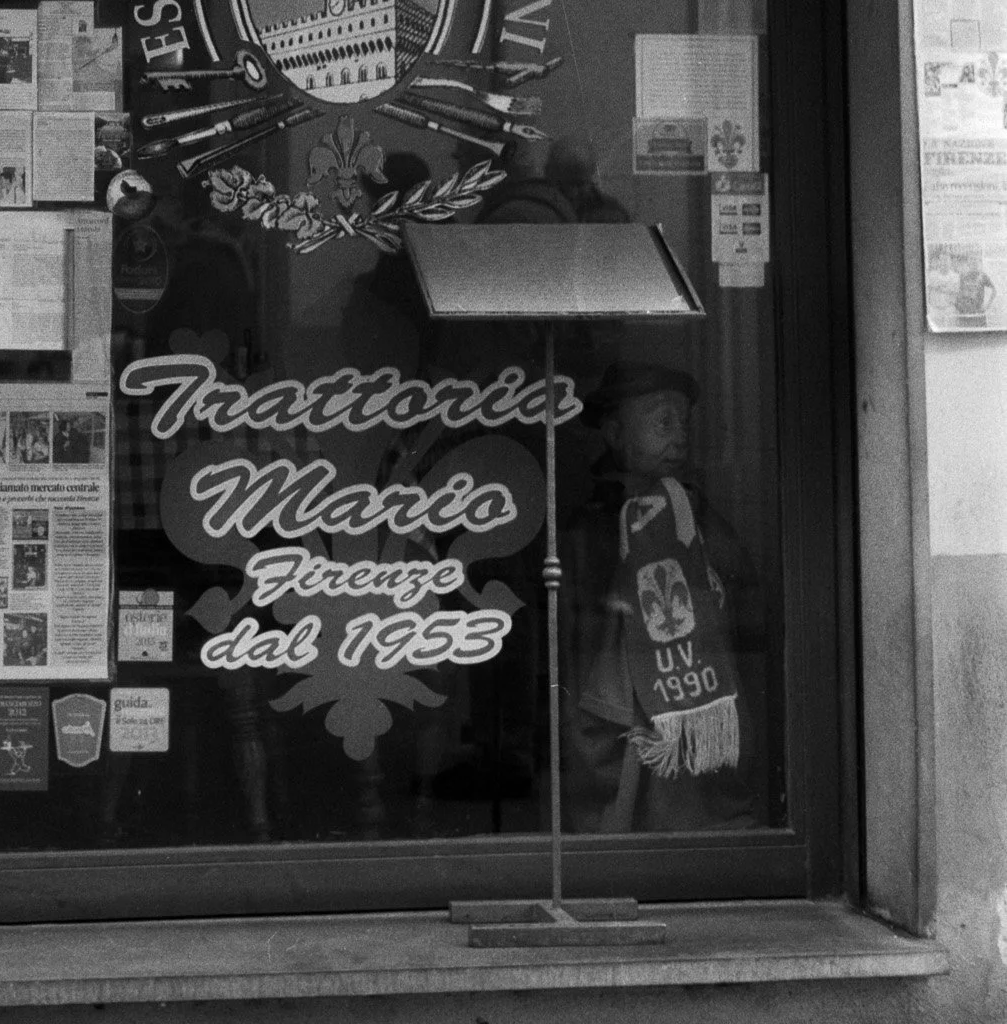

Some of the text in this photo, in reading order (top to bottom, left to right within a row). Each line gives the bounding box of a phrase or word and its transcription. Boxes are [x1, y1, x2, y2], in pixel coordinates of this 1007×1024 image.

[119, 354, 584, 439] Trattoria
[31, 483, 65, 493] mercato
[66, 482, 100, 493] centrale
[190, 459, 518, 539] Mario
[245, 546, 465, 609] Firenze
[200, 610, 512, 669] dal 1953
[653, 666, 720, 704] 1990
